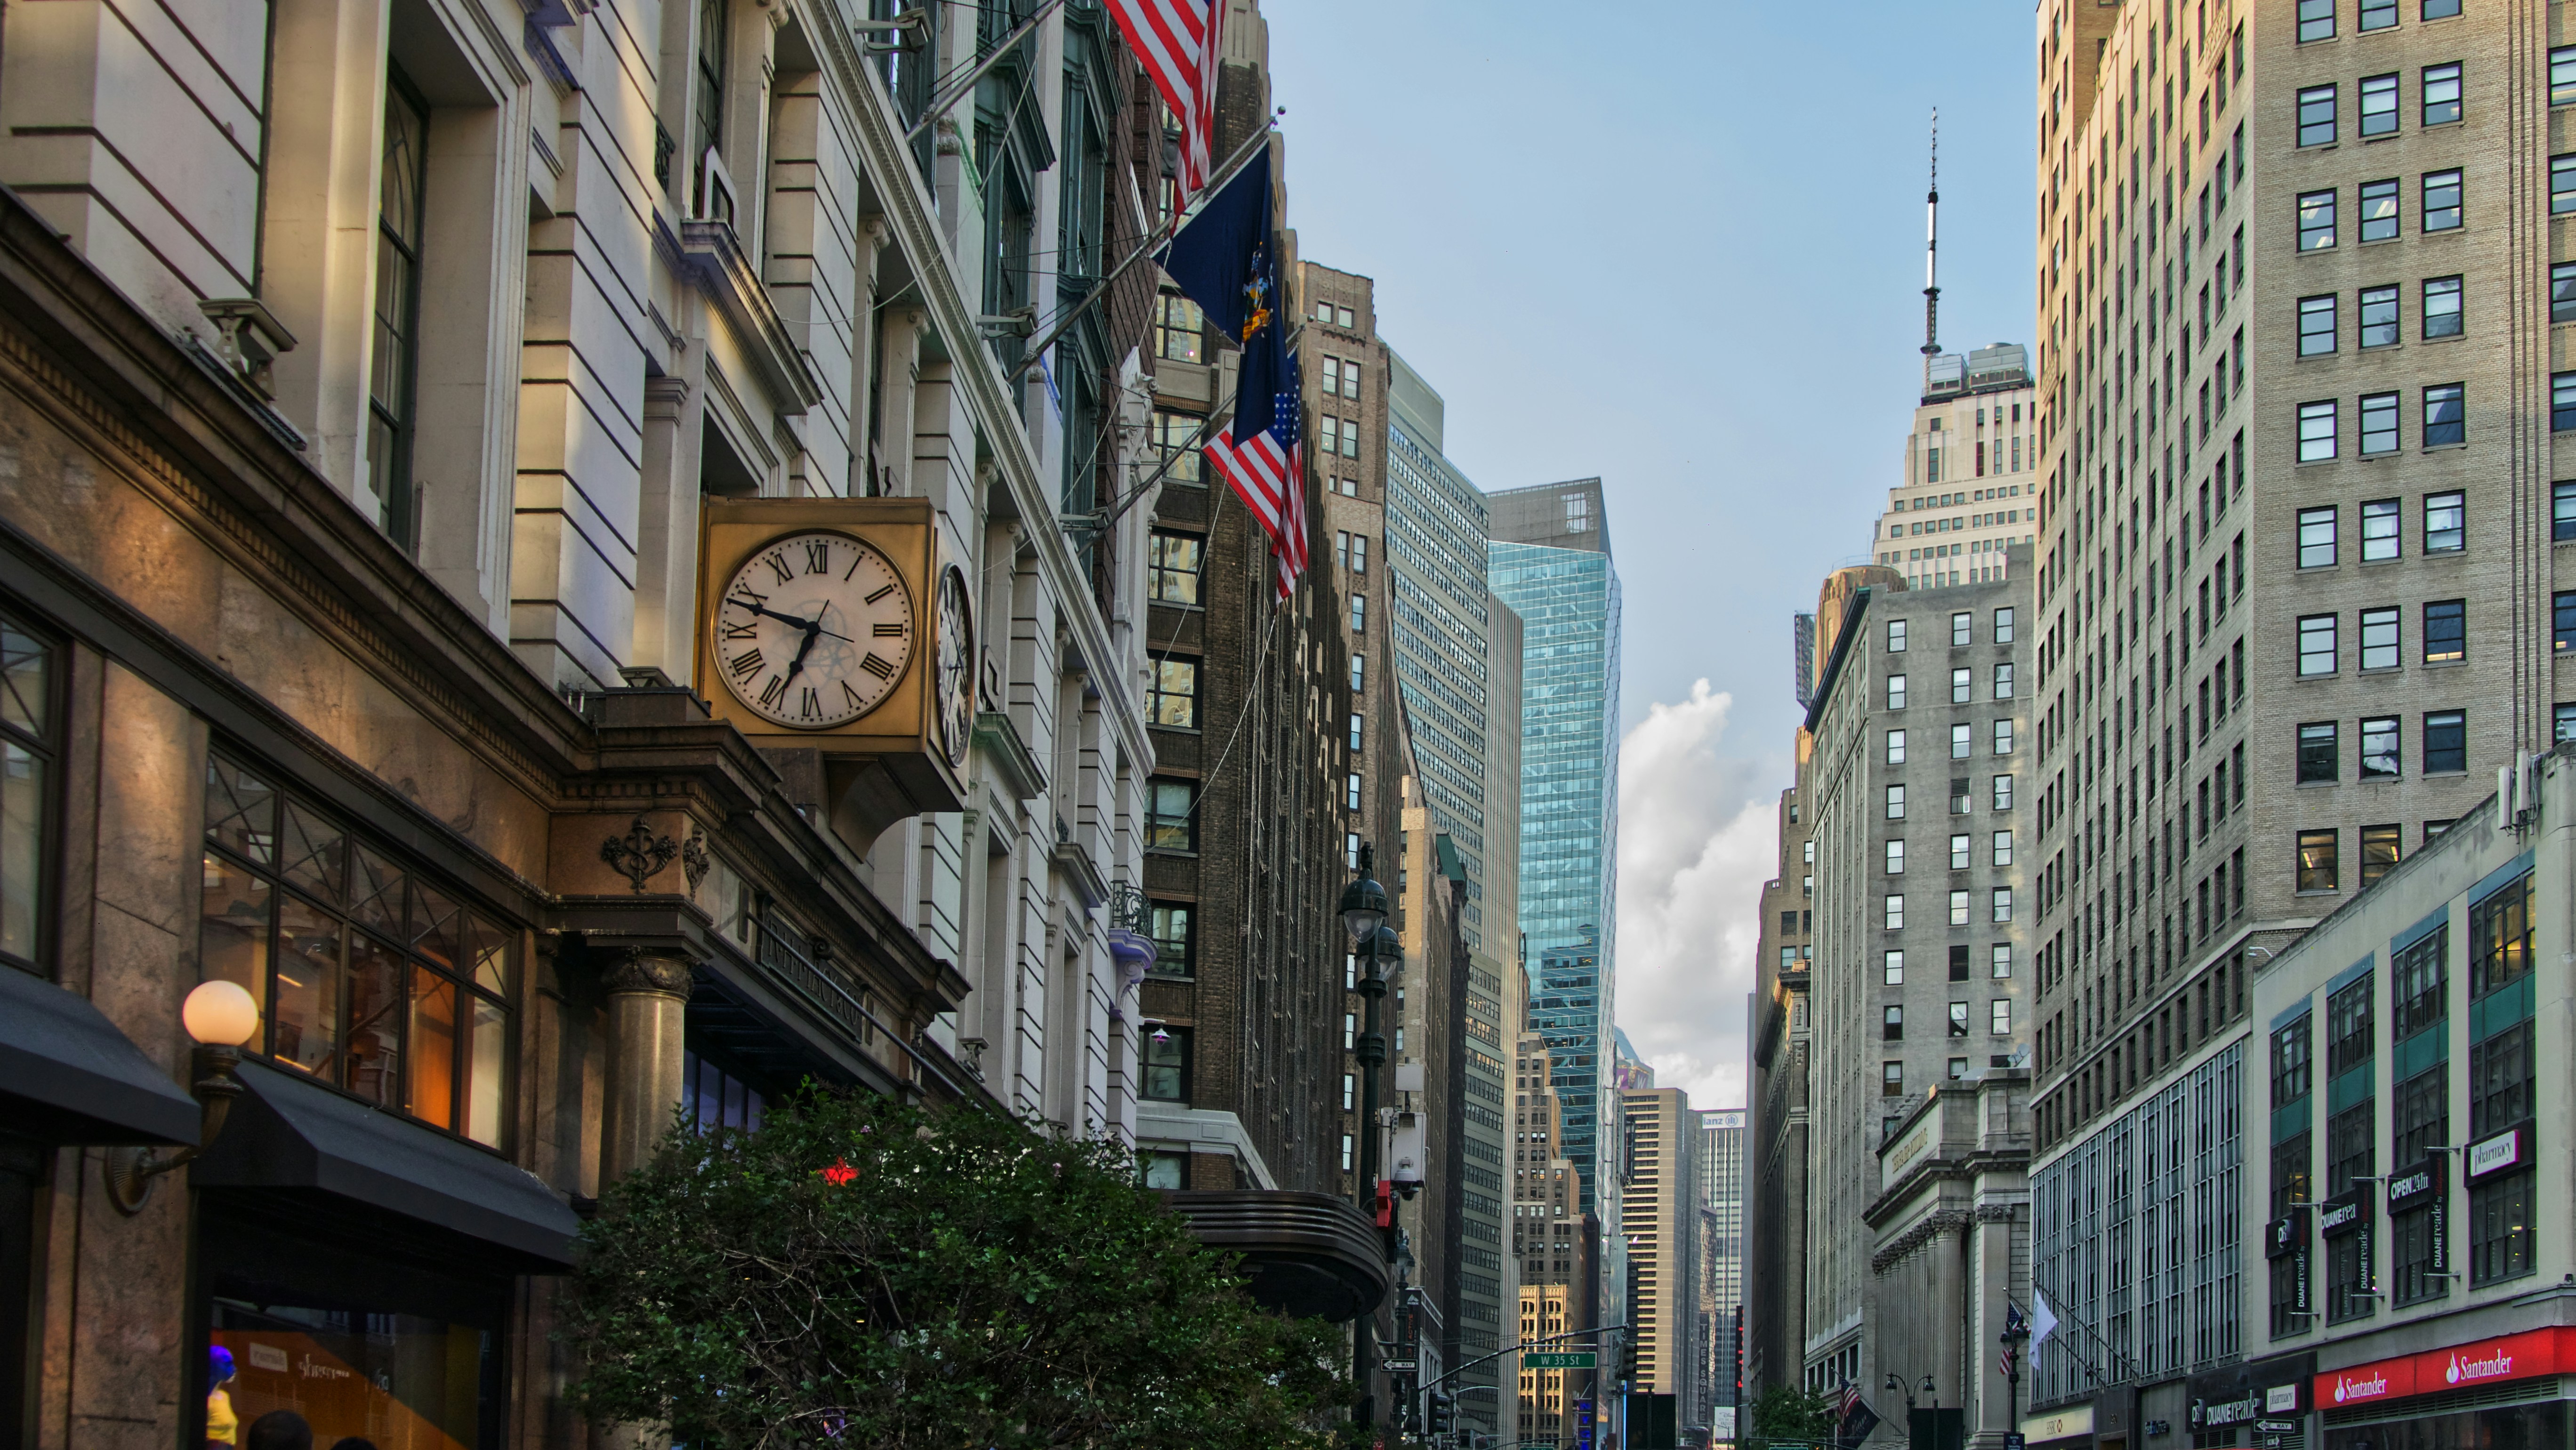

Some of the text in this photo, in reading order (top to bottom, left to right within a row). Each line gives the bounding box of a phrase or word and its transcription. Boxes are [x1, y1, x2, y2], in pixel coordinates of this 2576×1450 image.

[805, 544, 828, 574] XII
[2475, 1142, 2511, 1173] pharmacy
[2391, 1177, 2411, 1200] OPEN
[1541, 1355, 1579, 1365] W 35 St
[2461, 1348, 2512, 1380] Santander
[1699, 1369, 1707, 1421] SQUARE
[2346, 1371, 2386, 1399] Santander
[2269, 1391, 2293, 1410] pharmacy
[2046, 1420, 2057, 1435] HSBC
